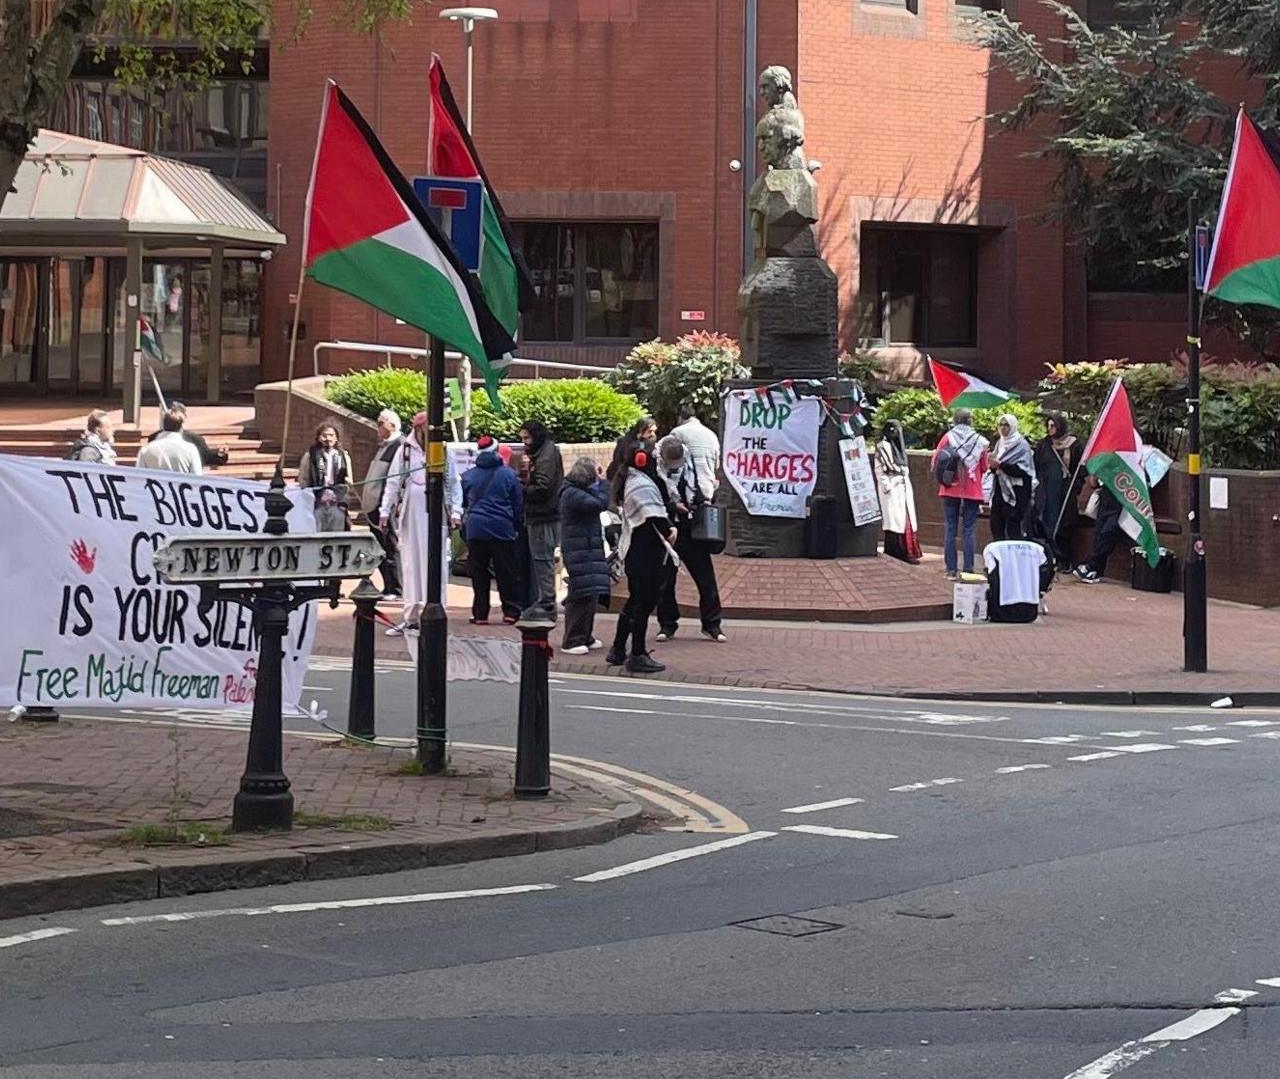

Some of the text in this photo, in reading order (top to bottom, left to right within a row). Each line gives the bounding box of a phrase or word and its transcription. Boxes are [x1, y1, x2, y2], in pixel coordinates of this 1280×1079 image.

[739, 401, 792, 430] DROP
[741, 437, 768, 450] THE
[727, 452, 815, 483] CHARGES
[45, 470, 138, 521] THE
[751, 482, 773, 494] ARE
[777, 482, 799, 496] ALL
[180, 545, 301, 573] NEWTON
[59, 584, 95, 636] IS
[114, 585, 190, 643] YOUR
[17, 646, 220, 702] Free Majid Freeman
